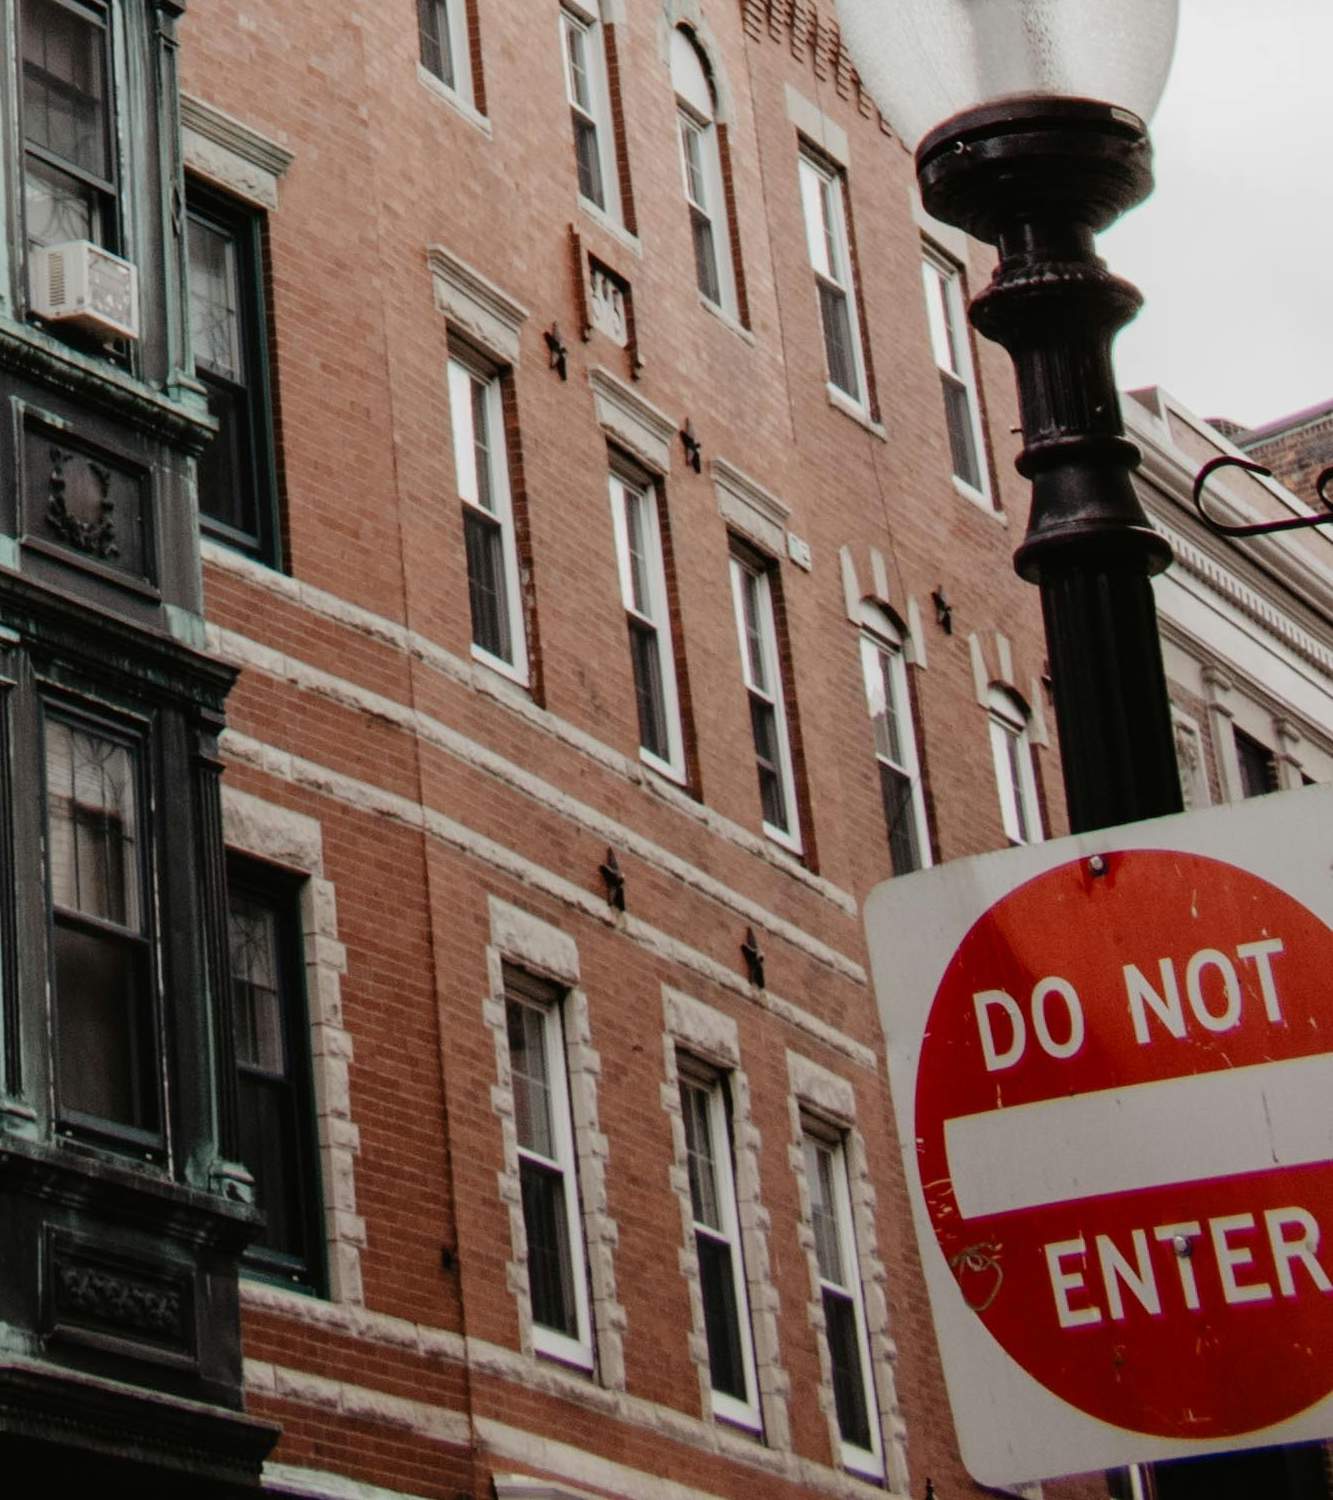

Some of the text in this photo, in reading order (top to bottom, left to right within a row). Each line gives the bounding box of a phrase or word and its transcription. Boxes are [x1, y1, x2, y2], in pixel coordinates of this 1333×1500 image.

[972, 937, 1284, 1073] DO NOT
[1043, 1205, 1333, 1329] ENTER
